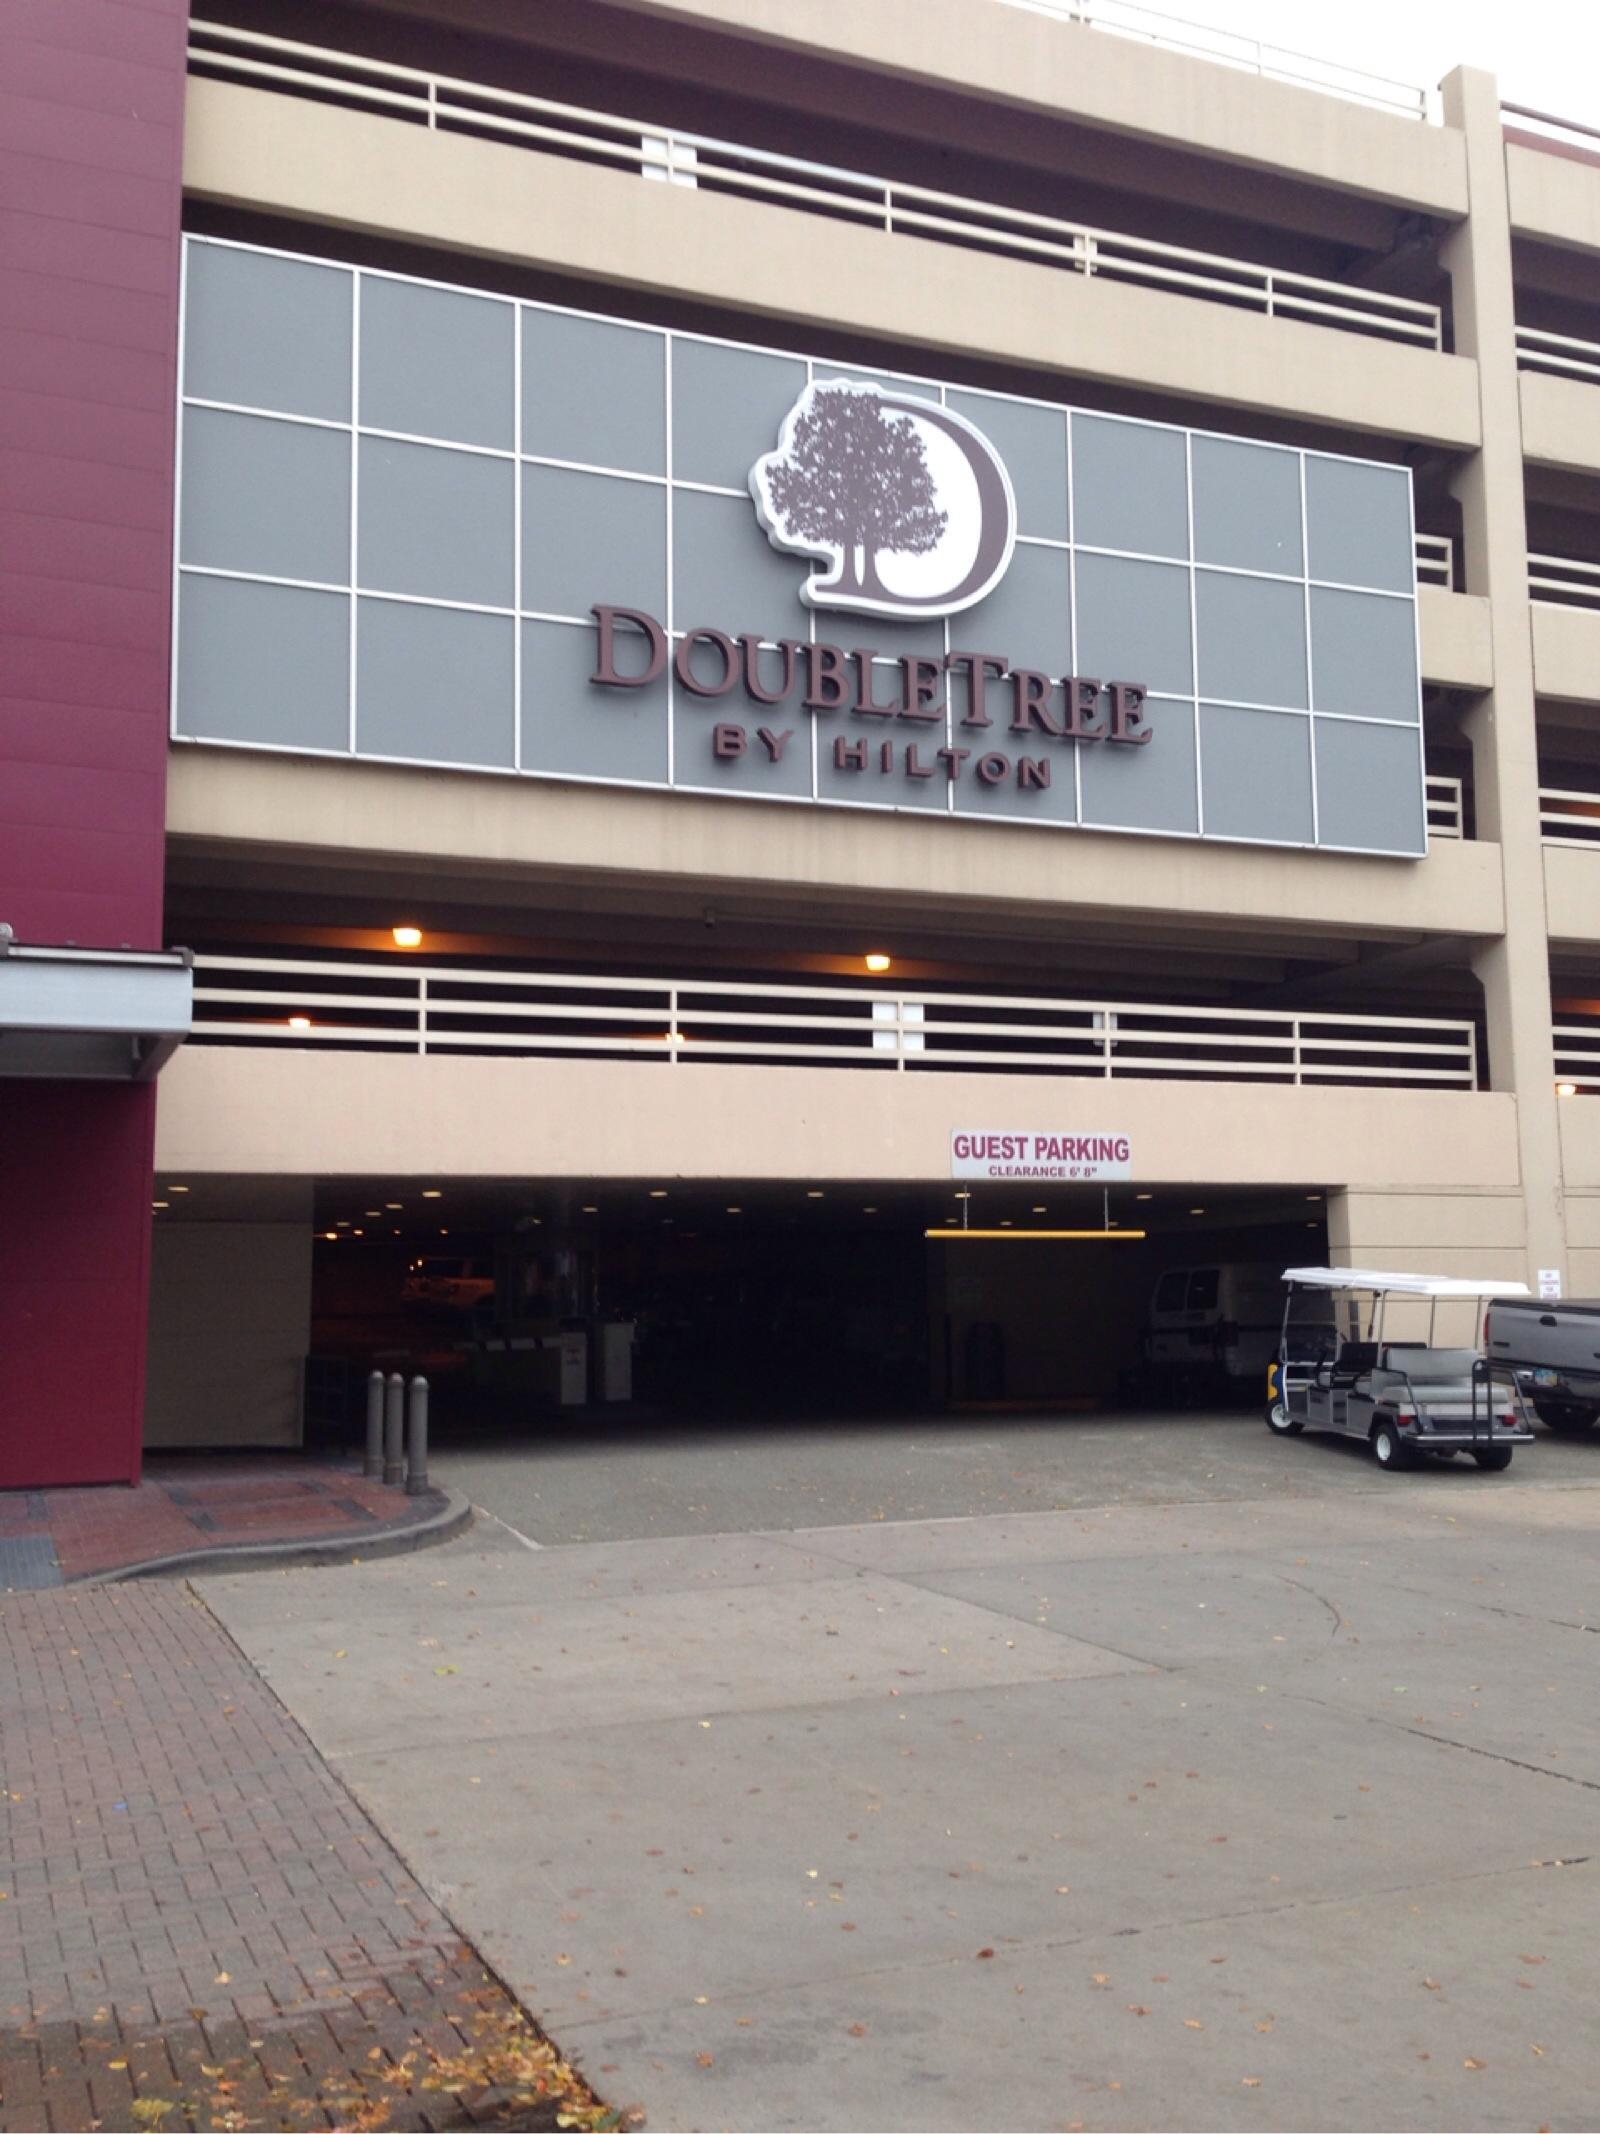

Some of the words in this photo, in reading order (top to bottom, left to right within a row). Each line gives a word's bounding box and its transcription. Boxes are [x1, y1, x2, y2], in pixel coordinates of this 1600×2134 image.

[712, 723, 793, 762] BY
[834, 736, 1051, 789] HILTON
[954, 1135, 1029, 1160] GUEST
[1034, 1136, 1129, 1162] PARKING
[988, 1165, 1066, 1178] CLEARANCE
[1069, 1166, 1081, 1178] 6'
